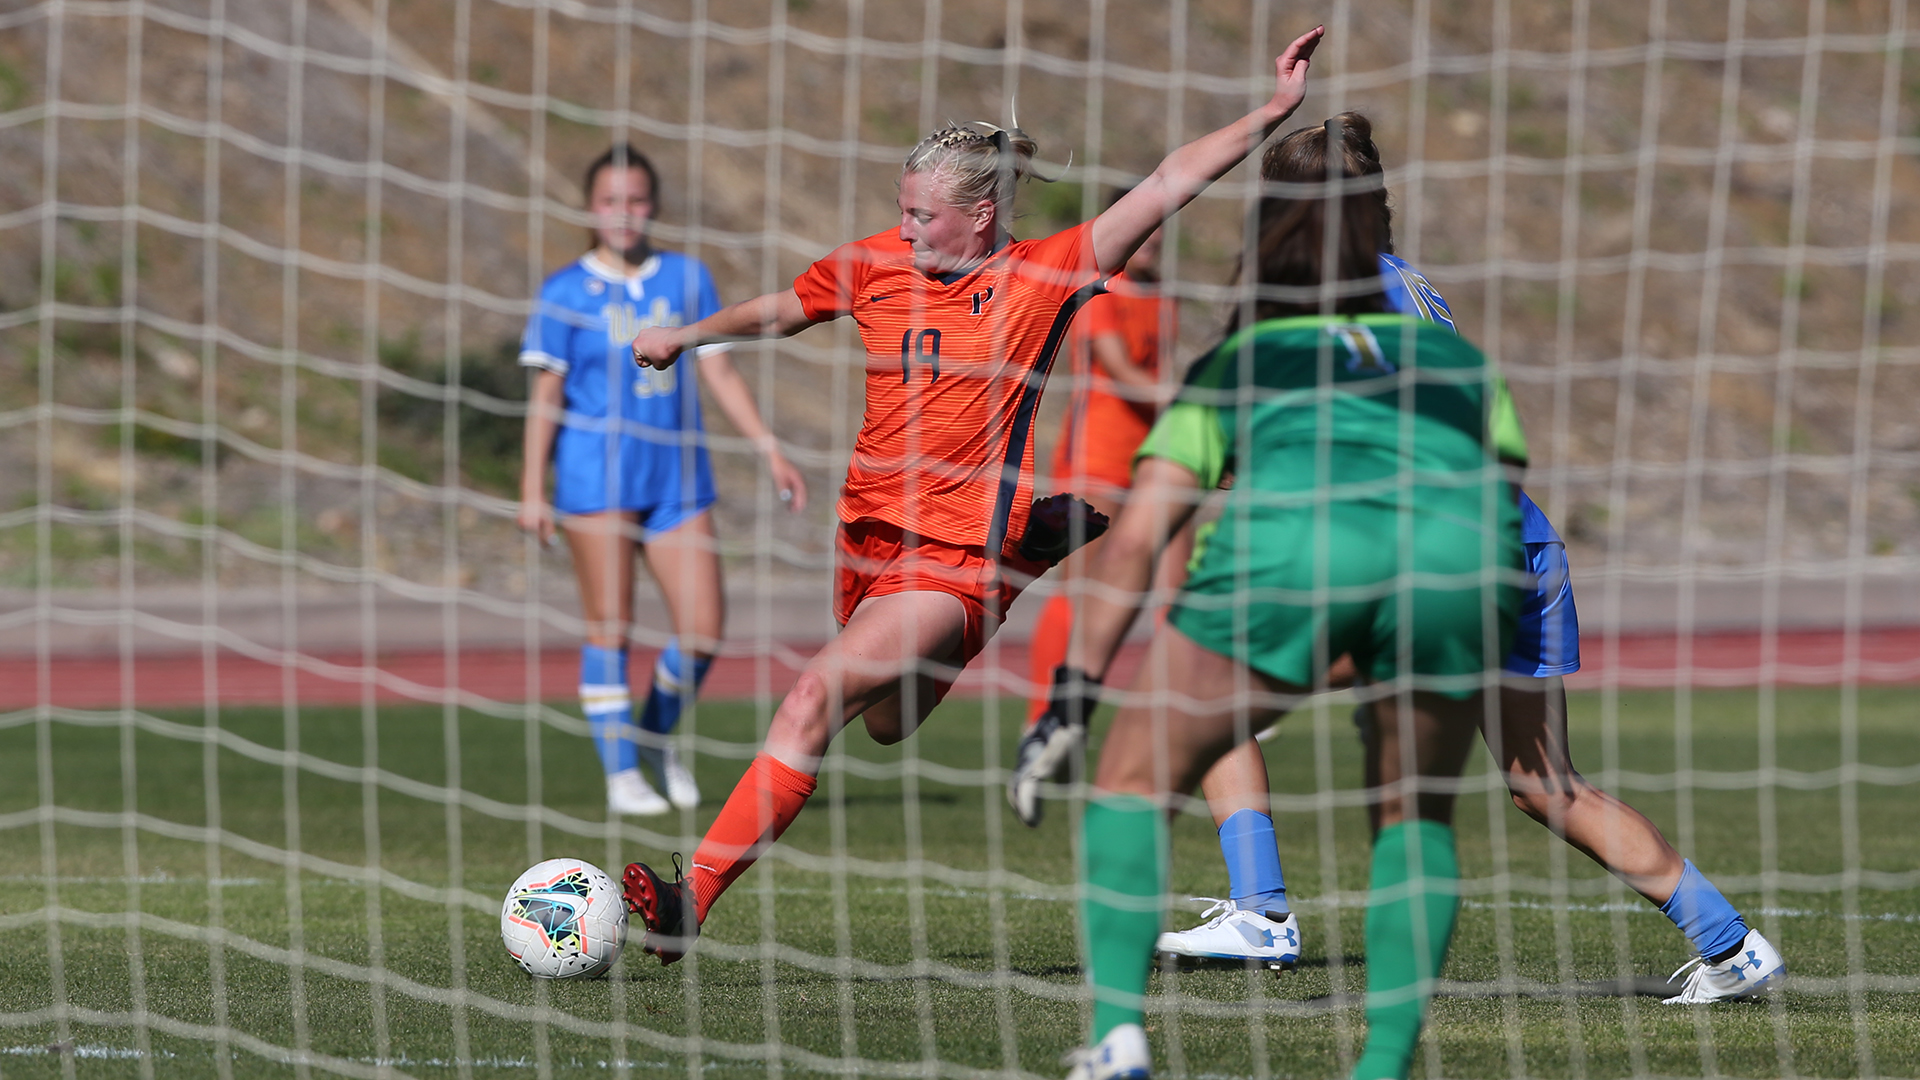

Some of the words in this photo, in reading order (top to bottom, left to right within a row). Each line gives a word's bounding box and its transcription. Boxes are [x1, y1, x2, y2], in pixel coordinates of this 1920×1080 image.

[969, 285, 995, 316] P
[901, 327, 942, 385] 19
[1326, 323, 1397, 375] 1
